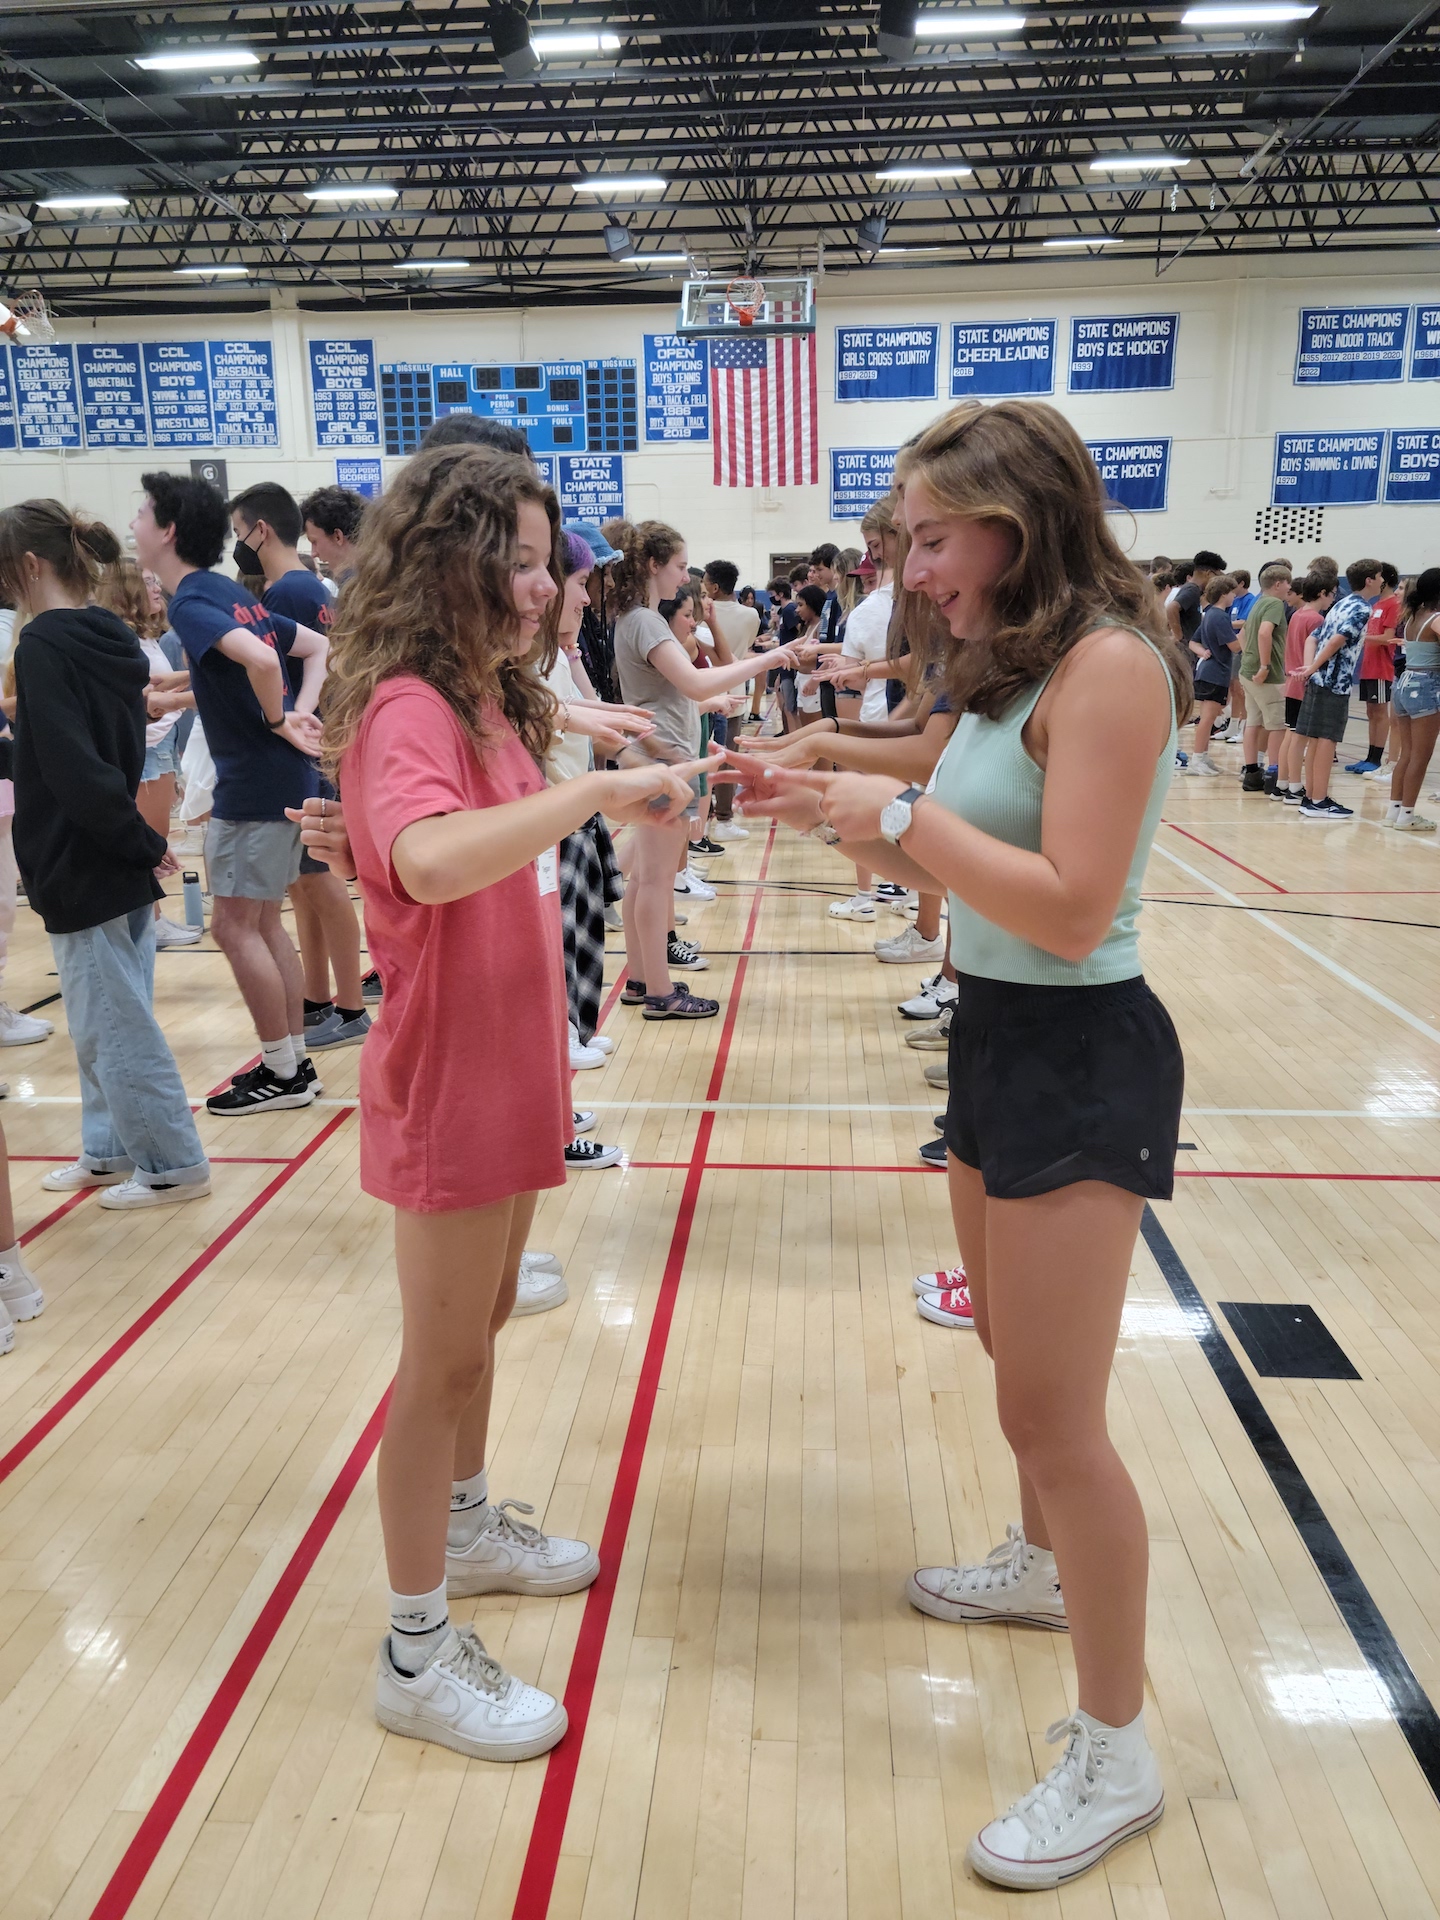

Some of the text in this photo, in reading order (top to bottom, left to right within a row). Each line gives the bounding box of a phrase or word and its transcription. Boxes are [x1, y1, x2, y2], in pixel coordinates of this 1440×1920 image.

[1308, 312, 1403, 330] STATE CHAMPIONS
[959, 326, 1050, 345] STATE CHAMPIONS
[1078, 321, 1171, 339] STATE CHAMPIONS
[843, 331, 933, 348] STATE CHAMPIONS
[1311, 332, 1395, 349] BOYS INDOOR TRACK
[27, 347, 57, 358] CCIL
[93, 349, 125, 359] CCIL
[159, 347, 191, 358] CCIL
[225, 343, 257, 354] CCIL
[325, 343, 357, 354] CCIL
[657, 348, 696, 360] OPEN
[957, 345, 1050, 363] CHEERLEADING
[1077, 340, 1169, 358] BOYS ICE HOCKEY
[215, 355, 268, 366] CHAMPIONS
[315, 354, 369, 366] CHAMPIONS
[843, 350, 931, 367] GIRLS CROSS COUNTRY
[1363, 352, 1381, 360] 2019
[17, 357, 70, 369] CHAMPIONS
[83, 363, 137, 374] CHAMPIONS
[149, 361, 203, 373] CHAMPIONS
[384, 364, 431, 373] NO DIGS KILLS
[589, 359, 637, 369] NO DIGS KILLS
[649, 360, 704, 372] CHAMPIONS
[1074, 363, 1092, 371] 1993
[18, 369, 40, 380] FIELD
[42, 369, 70, 380] HOCKEY
[217, 366, 267, 377] BASEBALL
[319, 366, 368, 377] TENNIS
[440, 368, 464, 379] HALL
[546, 366, 582, 377] VISITOR
[859, 371, 877, 379] 2019
[955, 368, 973, 376] 2016
[1301, 368, 1318, 376] 2022
[87, 377, 136, 388] BASKETBALL
[160, 376, 196, 387] BOYS
[652, 372, 701, 383] BOYS TENNIS
[48, 382, 72, 391] 1977
[326, 378, 363, 389] BOYS
[217, 389, 270, 400] BOYS GOLF
[662, 385, 691, 394] 1979
[27, 391, 68, 402] GIRLS
[95, 391, 131, 402] BOYS
[665, 395, 683, 406] TRACK
[684, 396, 690, 405] &
[691, 394, 707, 404] FIELD
[154, 406, 178, 415] 1970
[315, 402, 376, 411] 1970 1973 1977
[450, 406, 473, 414] BONUS
[490, 401, 515, 409] PERIOD
[226, 412, 266, 423] GIRLS
[316, 412, 334, 421] 1978
[338, 412, 356, 421] 1979
[518, 418, 539, 426] FOULS
[686, 416, 705, 427] TRACK
[97, 418, 136, 429] GIRLS
[155, 418, 210, 429] WRESTLING
[218, 423, 243, 433] TRACK
[253, 423, 275, 433] FIELD
[328, 422, 367, 433] GIRLS
[174, 433, 193, 442] 1978
[322, 434, 375, 444] 1978 1980
[663, 429, 692, 438] 2019
[1283, 437, 1379, 454] STATE CHAMPIONS
[1397, 435, 1429, 451] STATE
[1105, 445, 1164, 462] CHAMPIONS
[570, 457, 613, 469] STATE
[838, 455, 867, 469] STATE
[1281, 455, 1378, 472] BOYS SWIMMING & DIVING
[1400, 454, 1440, 469] BOYS
[203, 467, 215, 480] G
[572, 469, 611, 481] OPEN
[1102, 465, 1119, 480] ICE
[1121, 463, 1163, 479] HOCKEY
[339, 473, 380, 482] SCORERS
[840, 473, 872, 487] BOYS
[565, 481, 619, 493] CHAMPIONS
[836, 491, 871, 499] 1951 1952
[578, 506, 608, 516] 2019
